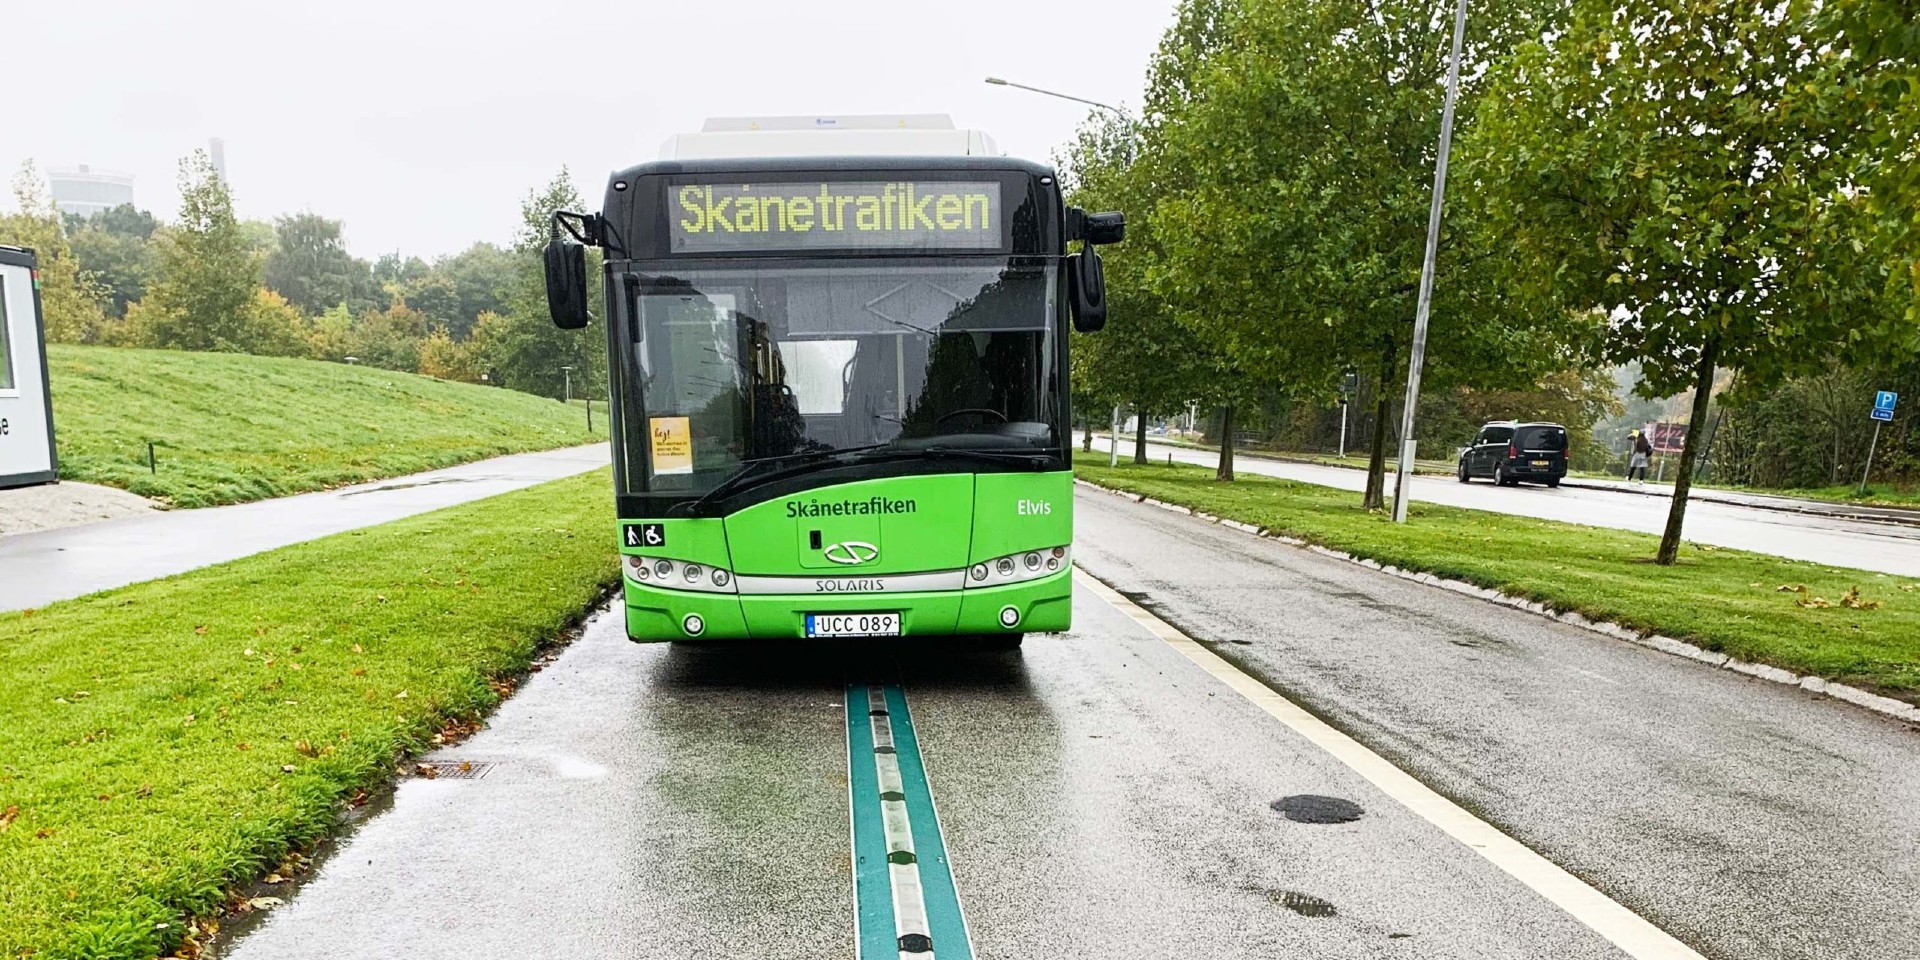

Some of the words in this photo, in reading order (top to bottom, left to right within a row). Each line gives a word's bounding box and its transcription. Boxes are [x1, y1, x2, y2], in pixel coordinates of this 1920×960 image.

[679, 183, 989, 232] Skånetrafiken
[1881, 393, 1893, 407] P
[786, 496, 917, 518] Skånetrafiken
[1017, 499, 1052, 516] Elvis
[816, 579, 884, 592] SOLARIS
[821, 617, 854, 632] UCC
[859, 616, 893, 632] 089
